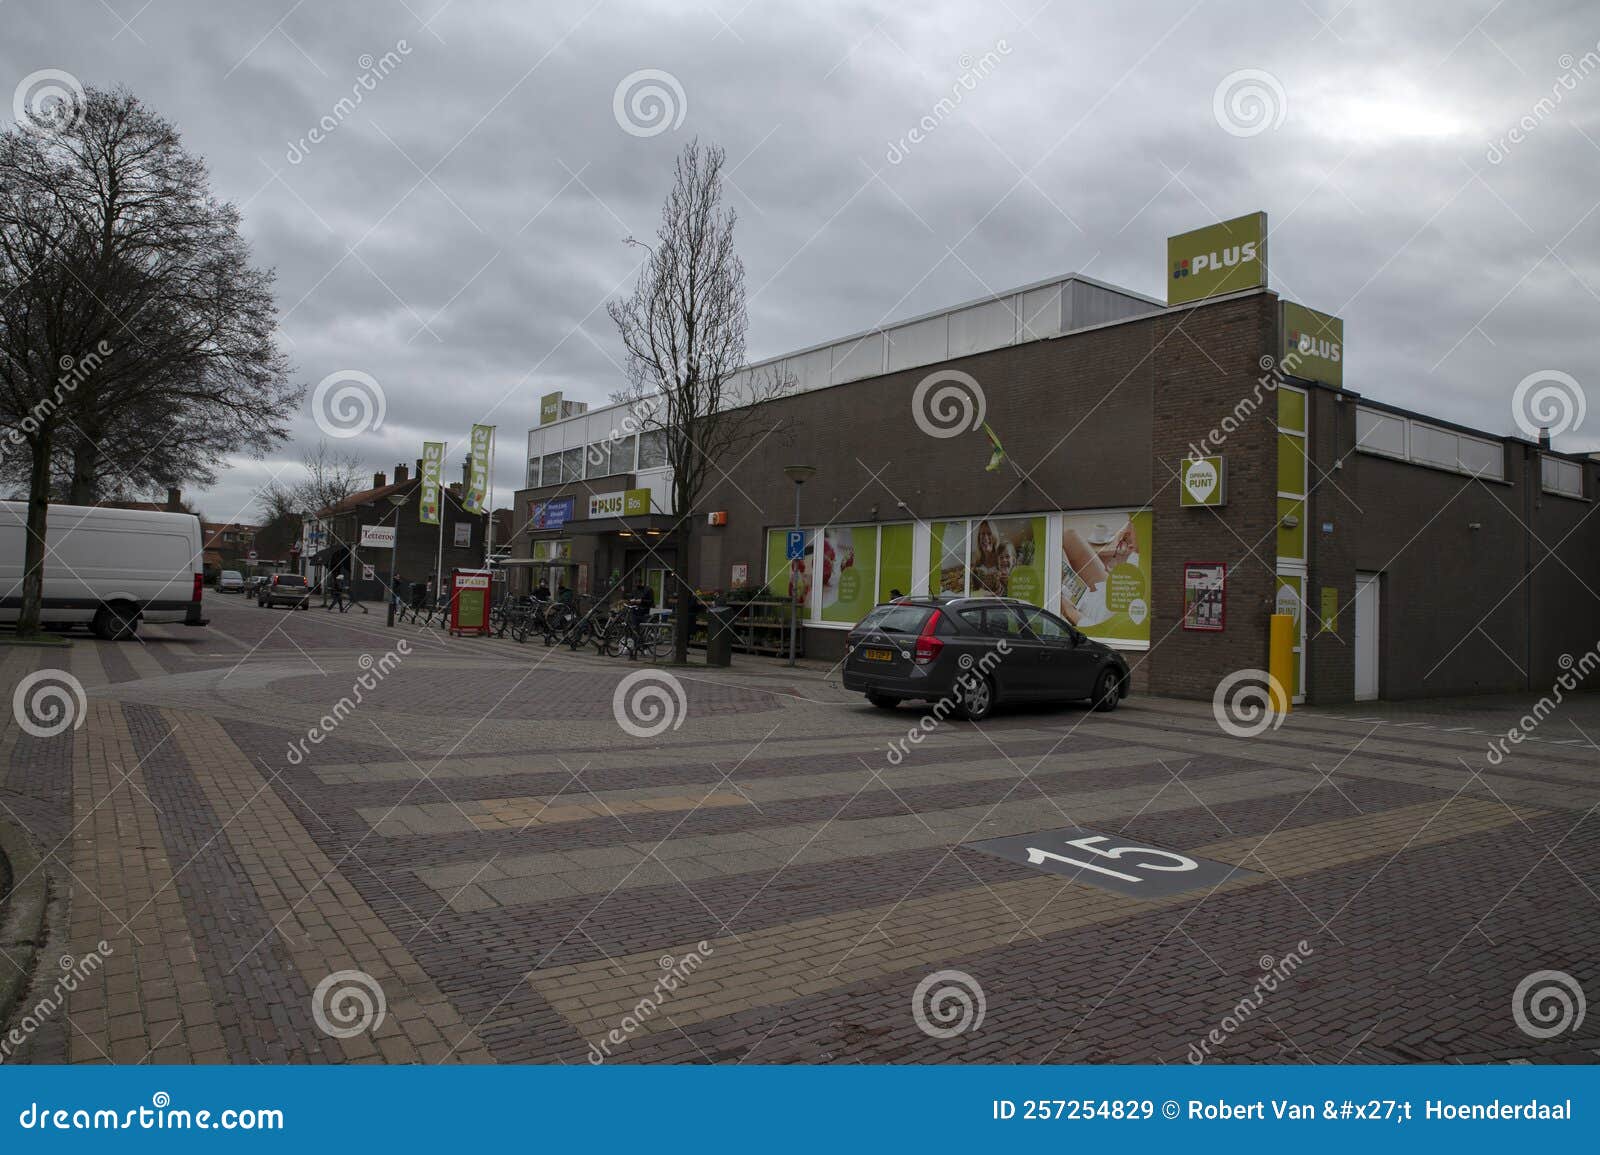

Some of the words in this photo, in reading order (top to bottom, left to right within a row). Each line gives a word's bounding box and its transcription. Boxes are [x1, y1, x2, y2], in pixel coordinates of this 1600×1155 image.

[1192, 241, 1256, 275] PLUS
[1298, 333, 1341, 362] PLUS
[1190, 479, 1213, 489] PUNT
[598, 497, 623, 514] PLUS
[362, 529, 394, 541] Tetteroo
[790, 533, 801, 548] P
[1025, 836, 1198, 882] 15
